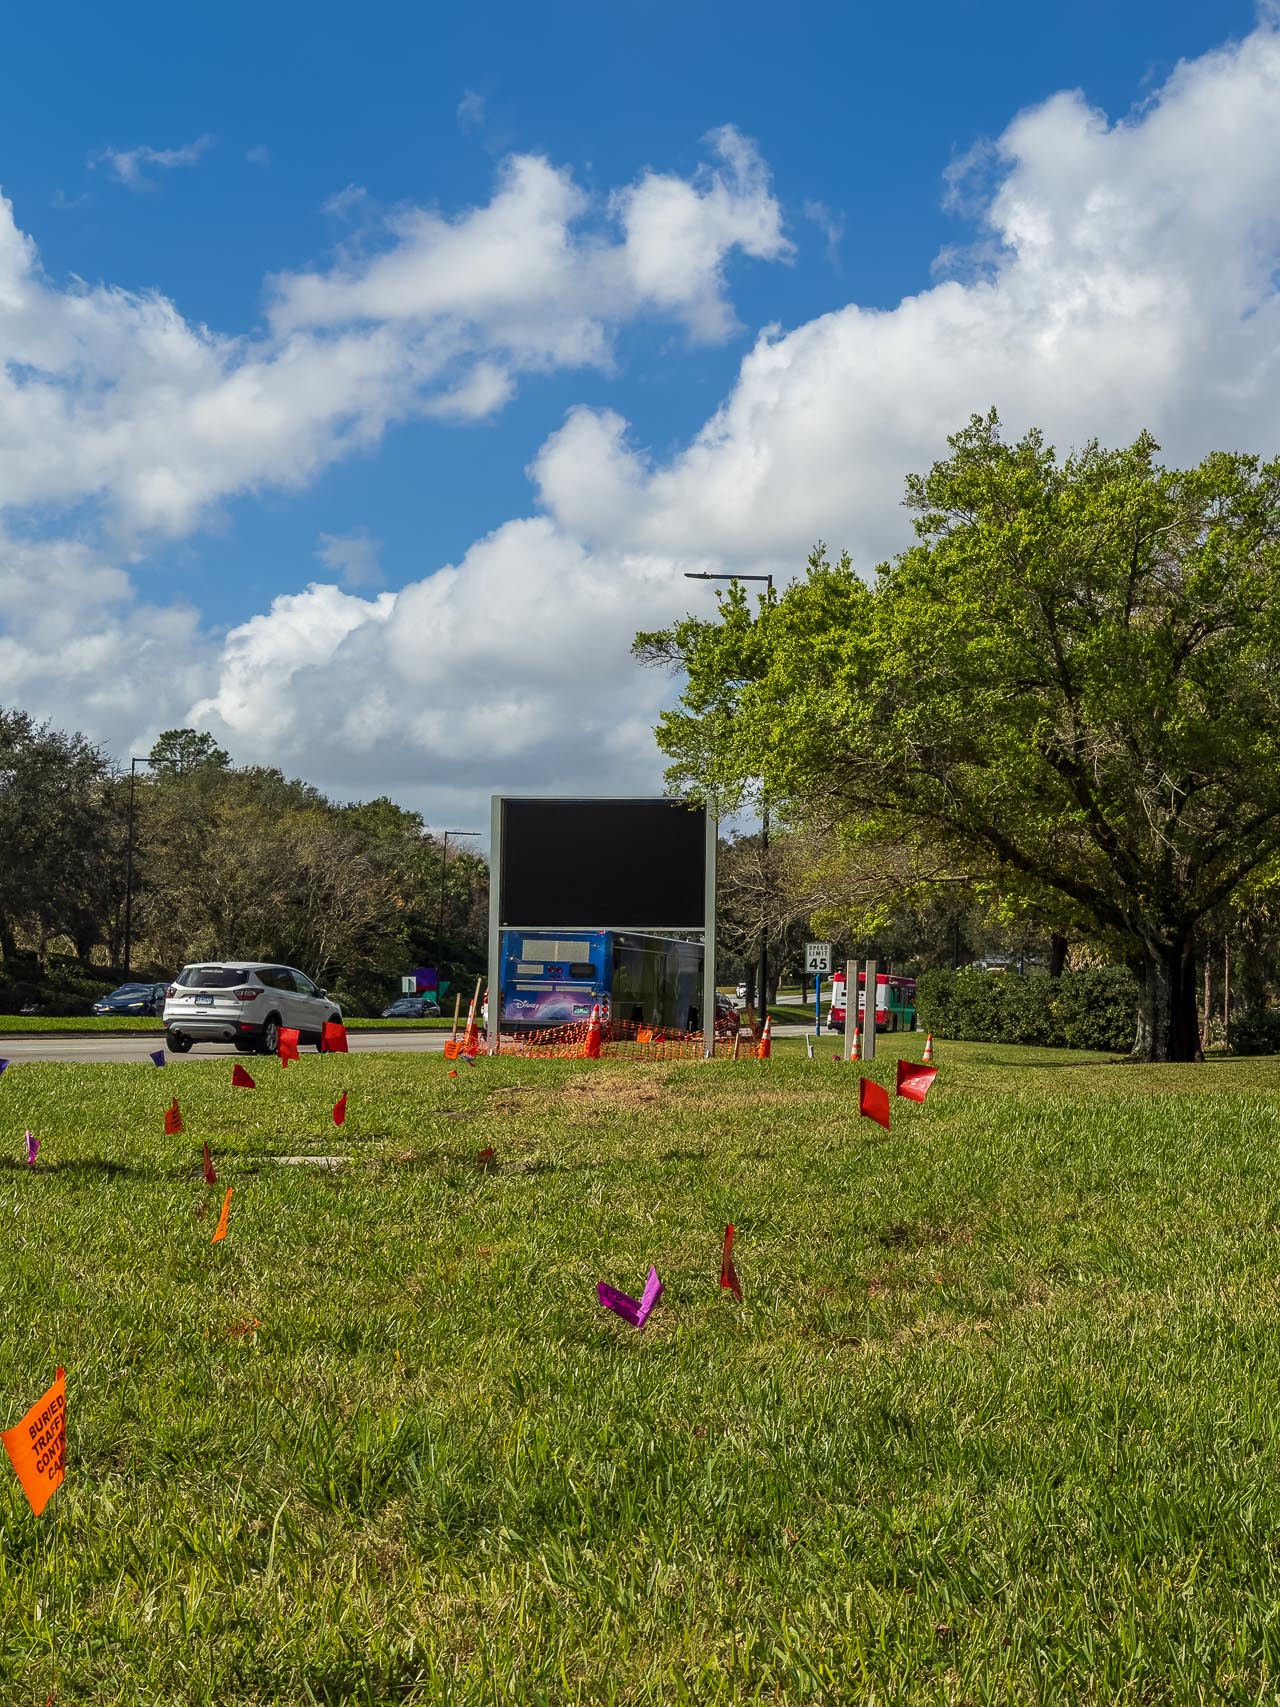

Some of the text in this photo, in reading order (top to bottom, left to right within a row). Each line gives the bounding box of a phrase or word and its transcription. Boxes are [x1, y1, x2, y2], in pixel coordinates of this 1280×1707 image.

[809, 958, 827, 970] 45
[28, 1394, 64, 1440] BURIED
[32, 1412, 65, 1456] TRAFFI
